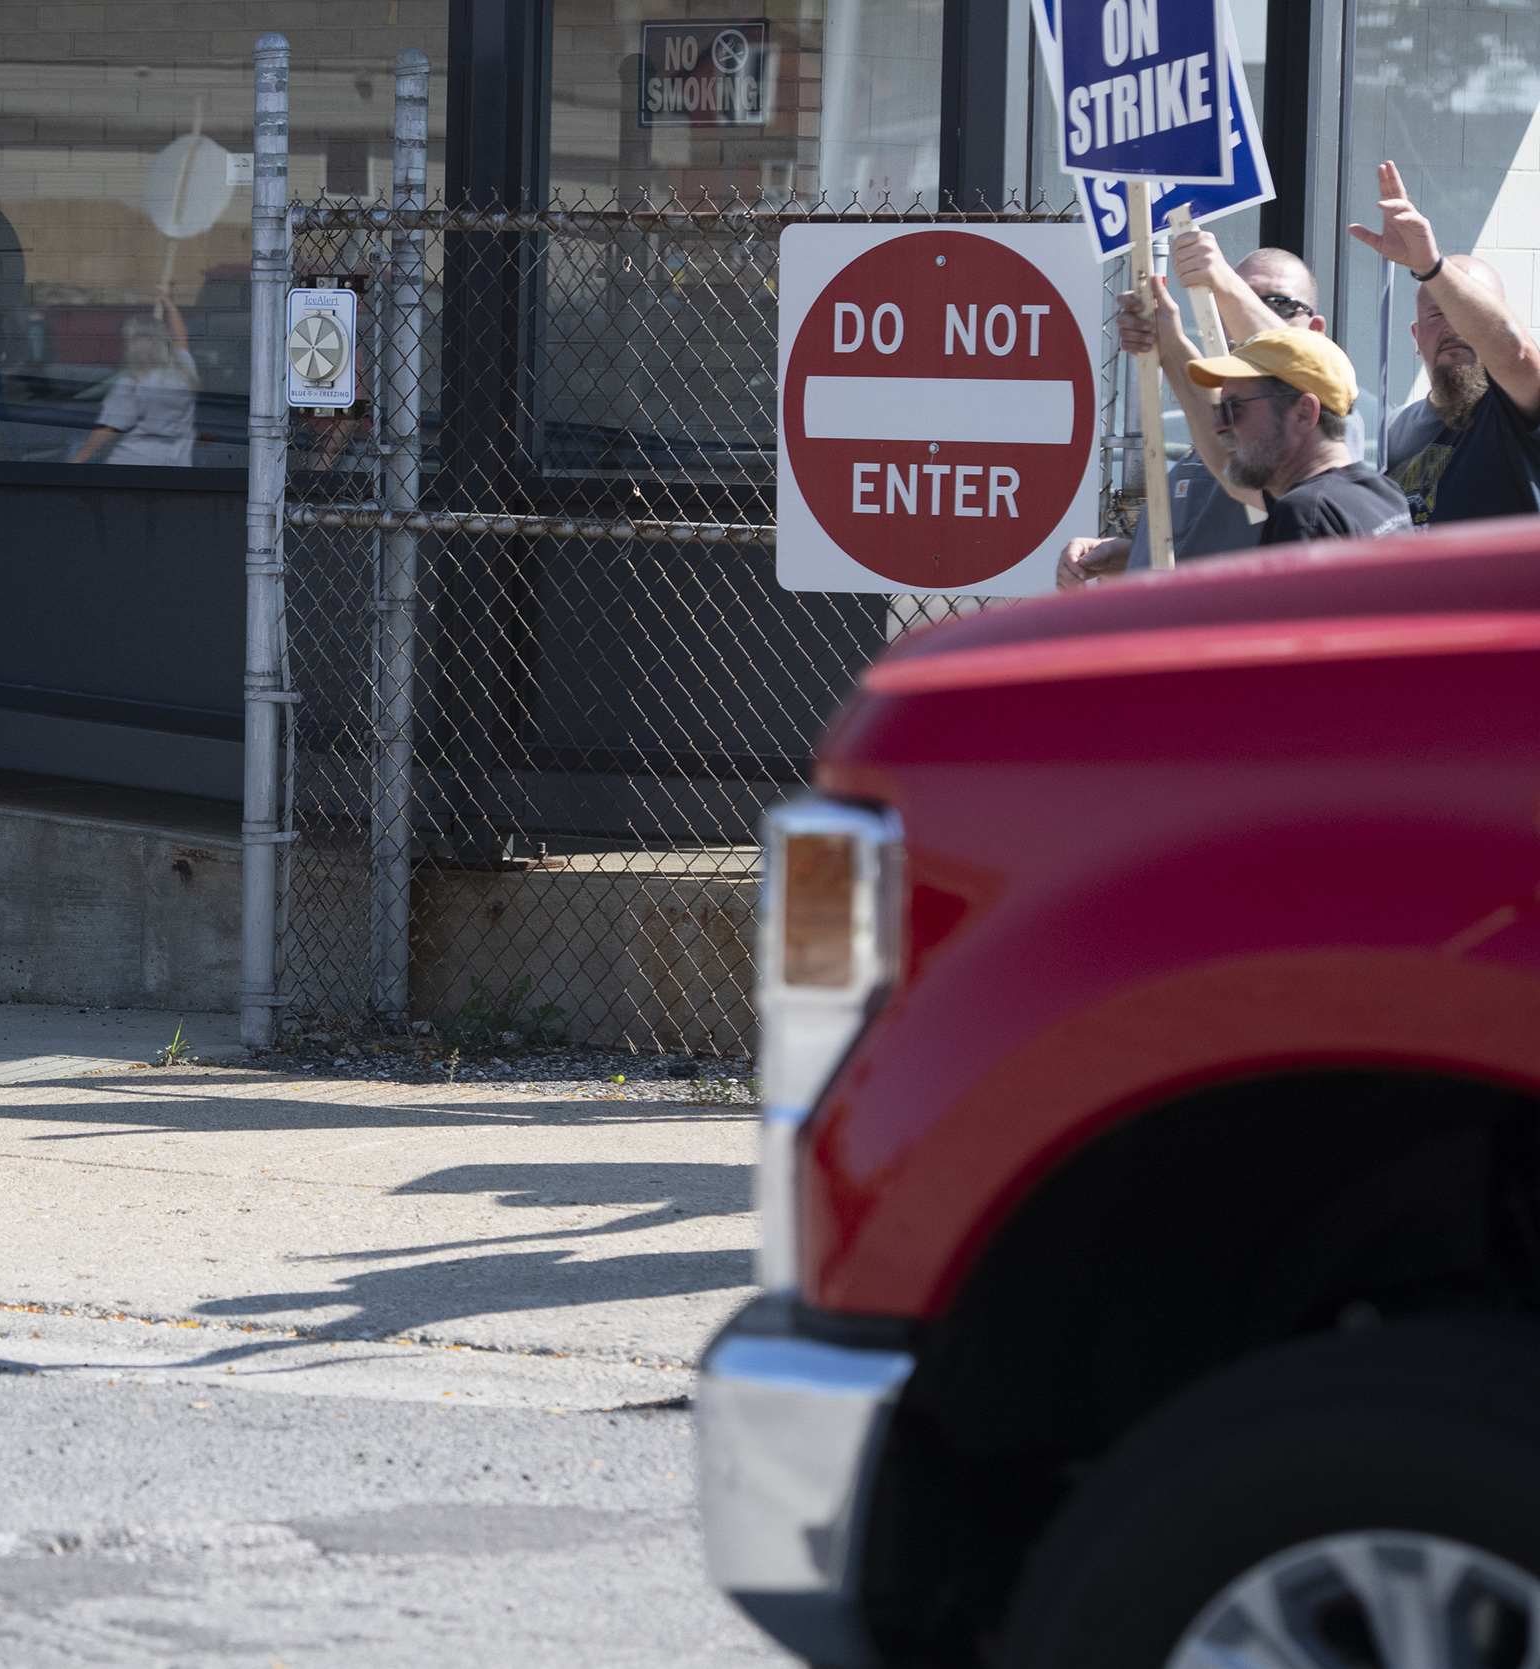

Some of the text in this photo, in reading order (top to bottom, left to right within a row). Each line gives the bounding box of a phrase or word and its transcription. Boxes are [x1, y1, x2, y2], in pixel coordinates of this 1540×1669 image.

[664, 36, 698, 71] NO
[1102, 0, 1159, 67] ON
[647, 76, 758, 112] SMOKING
[1067, 52, 1212, 156] STRIKE
[304, 295, 339, 305] IceAlert
[833, 302, 1051, 357] DO NOT
[319, 390, 350, 398] FREEZING
[852, 462, 1021, 518] ENTER
